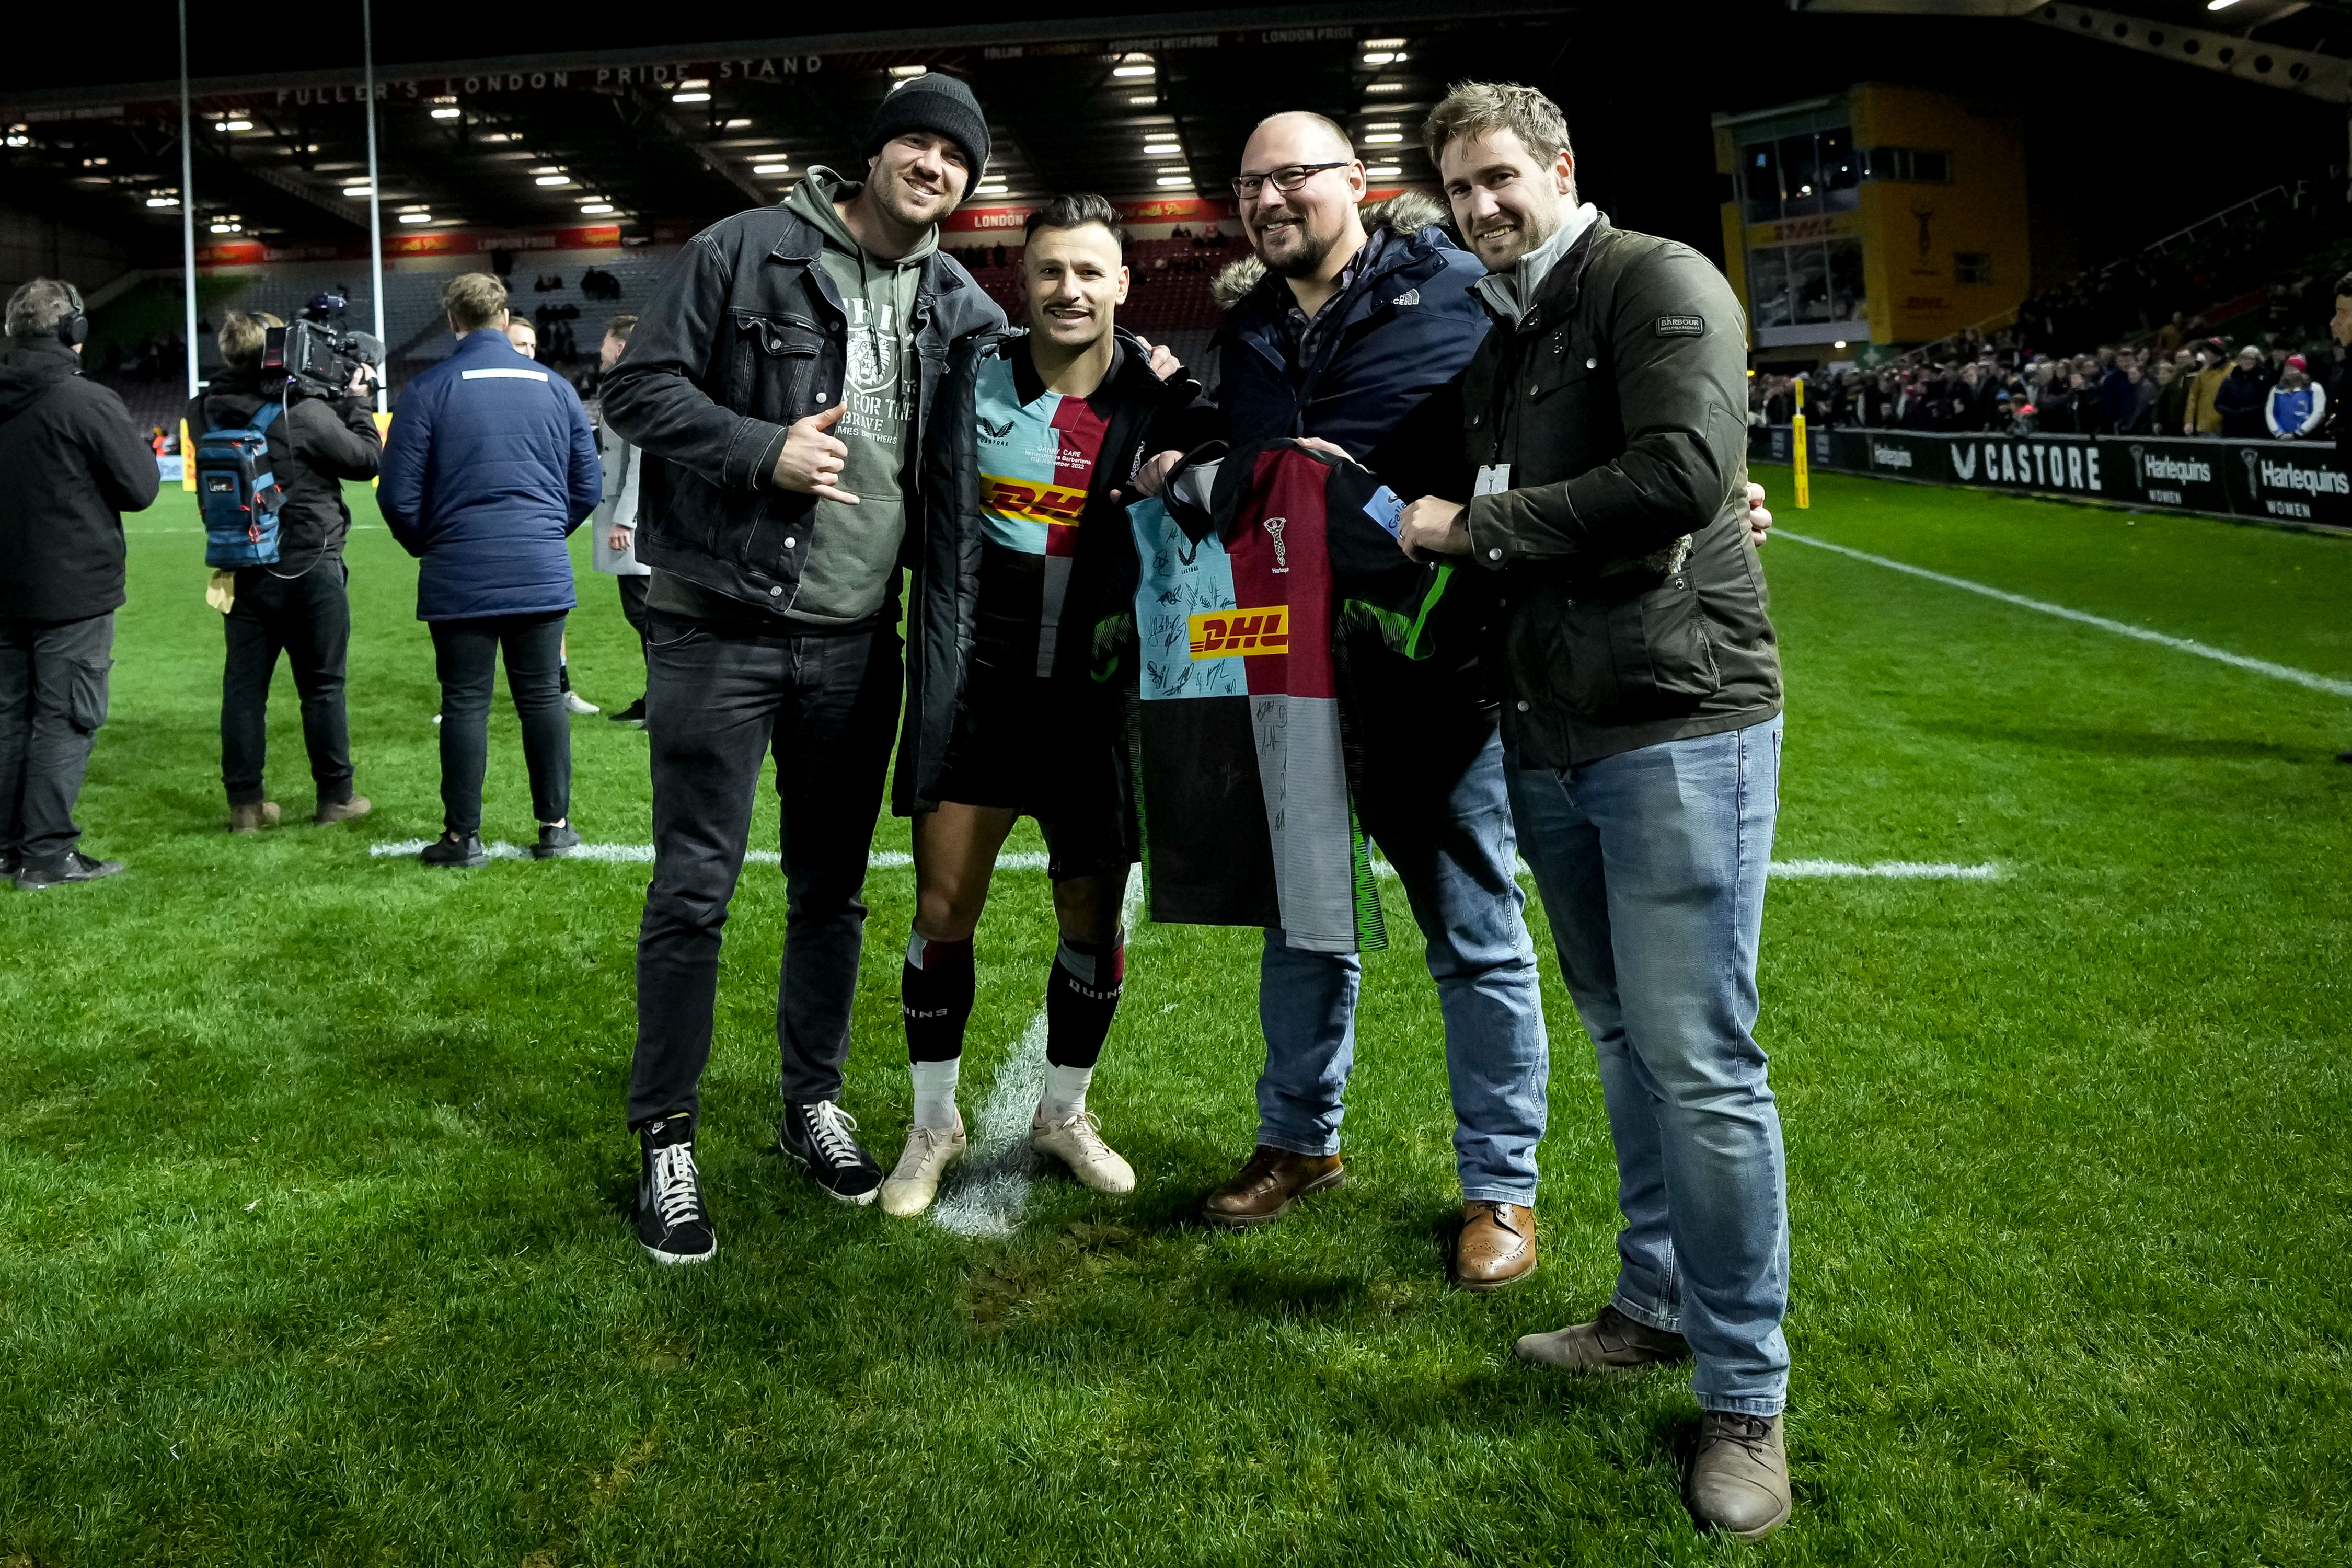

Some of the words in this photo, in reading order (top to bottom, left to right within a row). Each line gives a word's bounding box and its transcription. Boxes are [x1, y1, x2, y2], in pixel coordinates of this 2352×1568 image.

[276, 80, 418, 107] FULLER'S
[445, 72, 568, 95] LONDON
[596, 63, 690, 85] PRIDE
[720, 55, 822, 79] STAND
[974, 212, 1024, 228] LONDON
[854, 392, 881, 416] FOR
[841, 411, 884, 432] BRAVE
[981, 439, 1009, 447] CASTORE
[1037, 446, 1060, 454] DANNY
[1042, 459, 1070, 467] November
[1062, 456, 1092, 465] Barbarians
[1985, 443, 2102, 491] CASTORE
[2144, 454, 2211, 486] Harlequins
[2261, 460, 2350, 496] Harlequins
[991, 482, 1088, 518] DH
[2266, 500, 2311, 518] WOMEN
[1388, 502, 1407, 529] Galla
[1203, 614, 1288, 651] DHL
[903, 1005, 948, 1018] UINS
